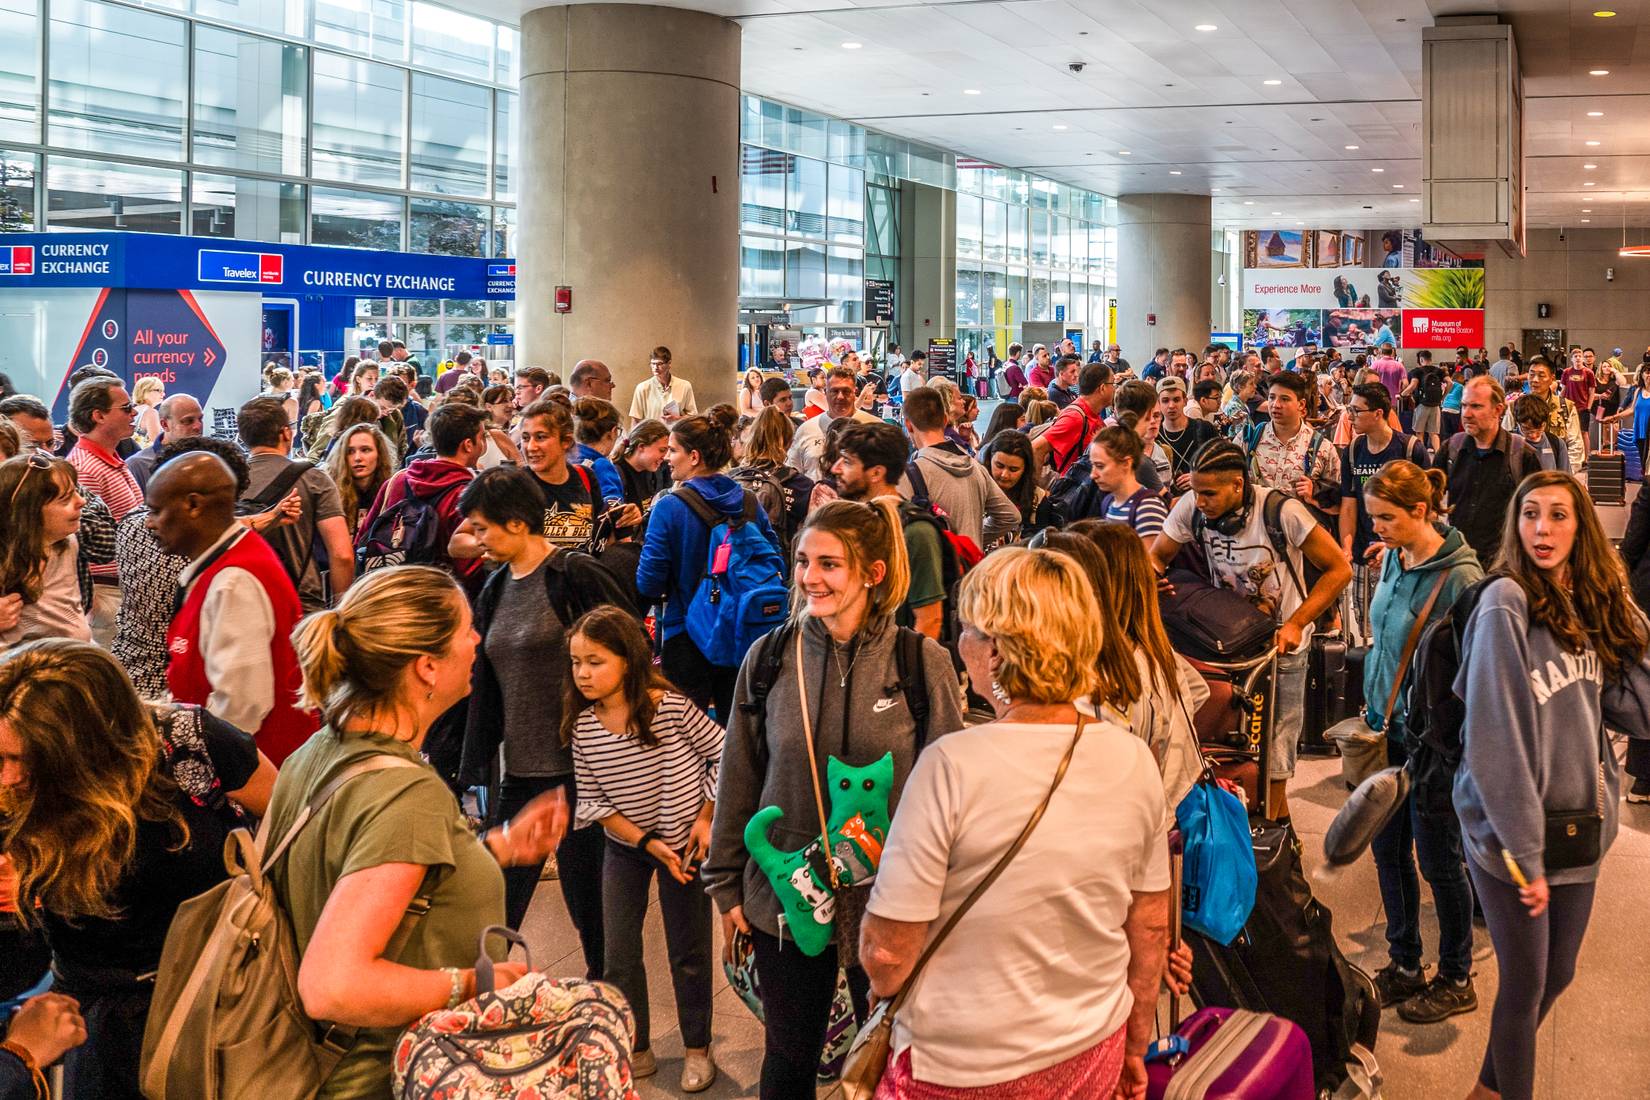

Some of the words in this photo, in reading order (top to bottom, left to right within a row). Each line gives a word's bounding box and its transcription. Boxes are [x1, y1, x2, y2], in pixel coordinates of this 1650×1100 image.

[41, 244, 109, 256] CURRENCY
[41, 261, 110, 274] EXCHANGE
[222, 266, 257, 279] Travelex
[303, 270, 382, 288] CURRENCY
[385, 274, 455, 291] EXCHANGE
[1254, 283, 1299, 295] Experience
[1300, 283, 1322, 294] More
[1431, 326, 1443, 334] Fine
[1444, 326, 1456, 334] Arts
[1456, 326, 1474, 334] Boston
[133, 329, 153, 345] All
[156, 333, 189, 348] your
[1431, 335, 1452, 343] mfa.org
[133, 352, 196, 366] currency
